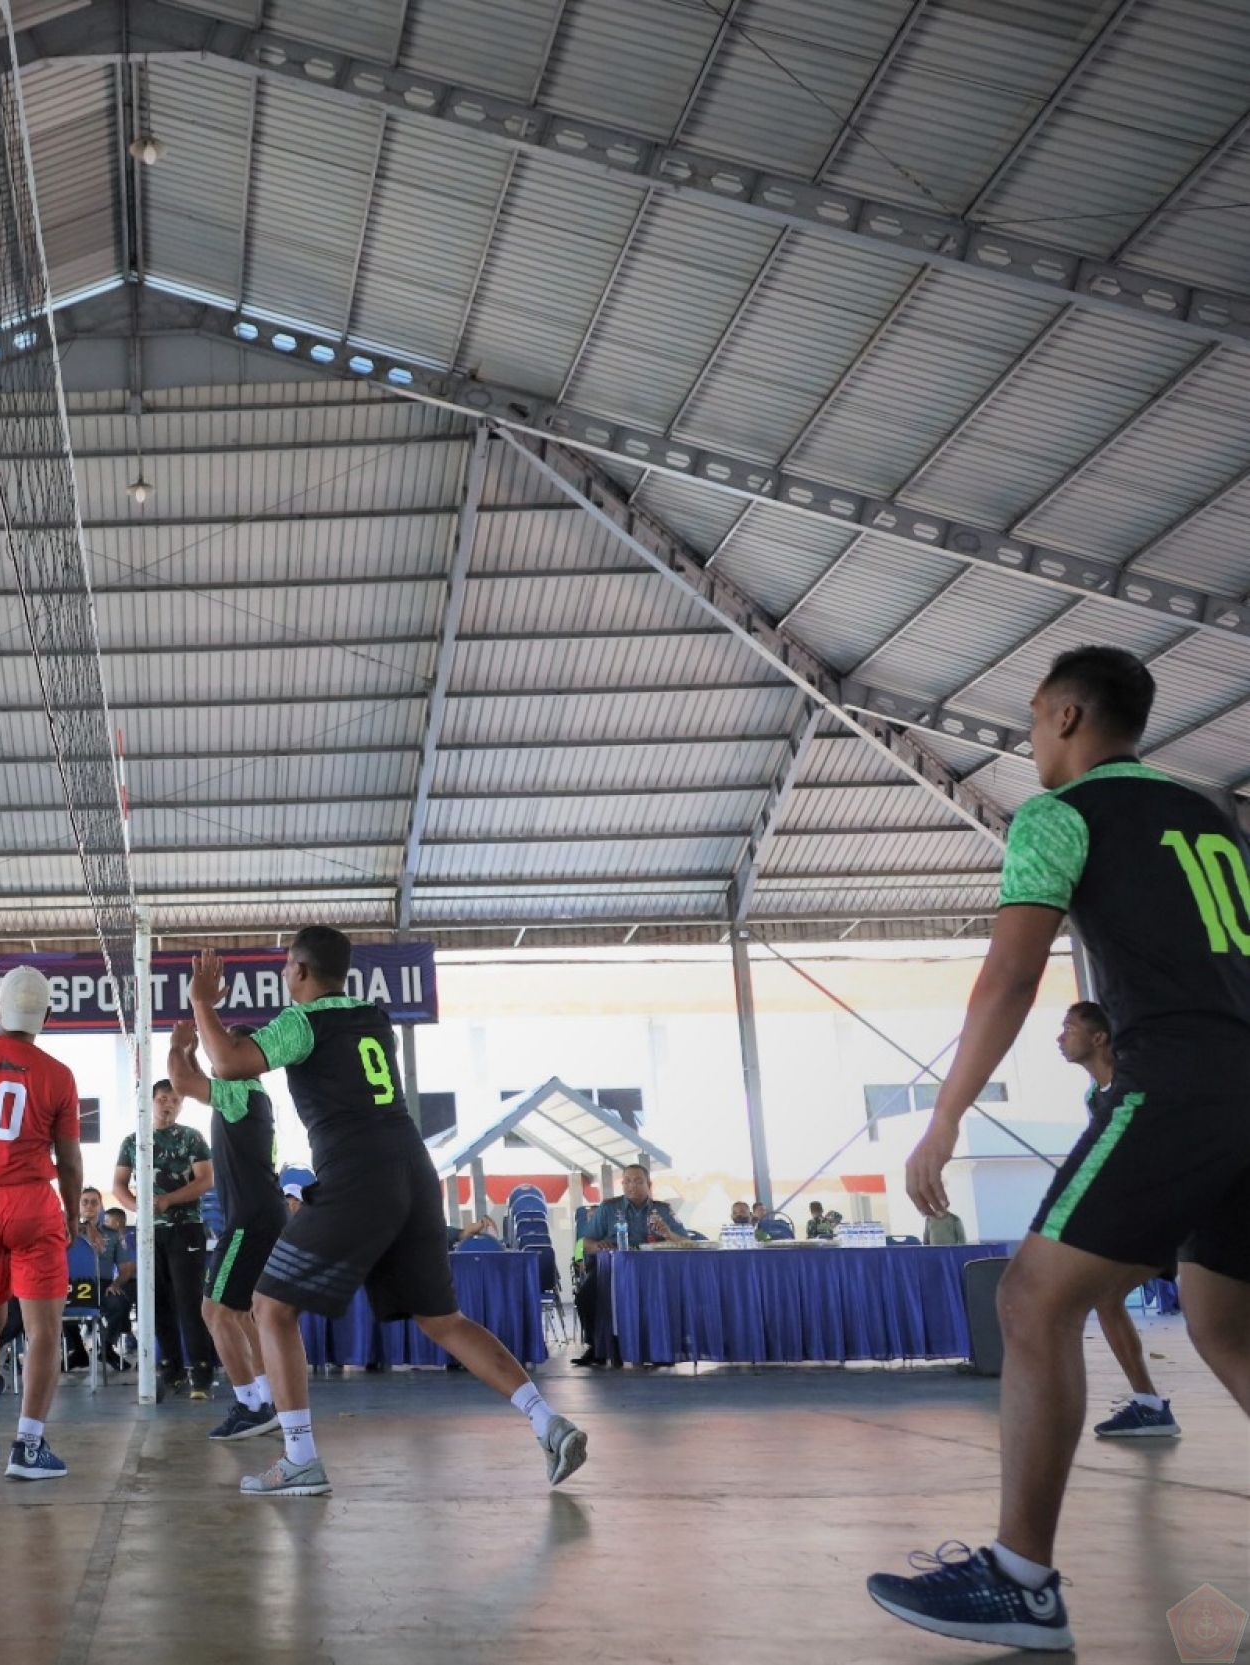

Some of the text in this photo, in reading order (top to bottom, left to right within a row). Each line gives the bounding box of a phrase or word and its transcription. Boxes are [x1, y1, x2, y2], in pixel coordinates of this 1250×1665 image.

[1160, 830, 1250, 957] 10
[358, 1037, 394, 1105] 9
[77, 1284, 92, 1299] 2
